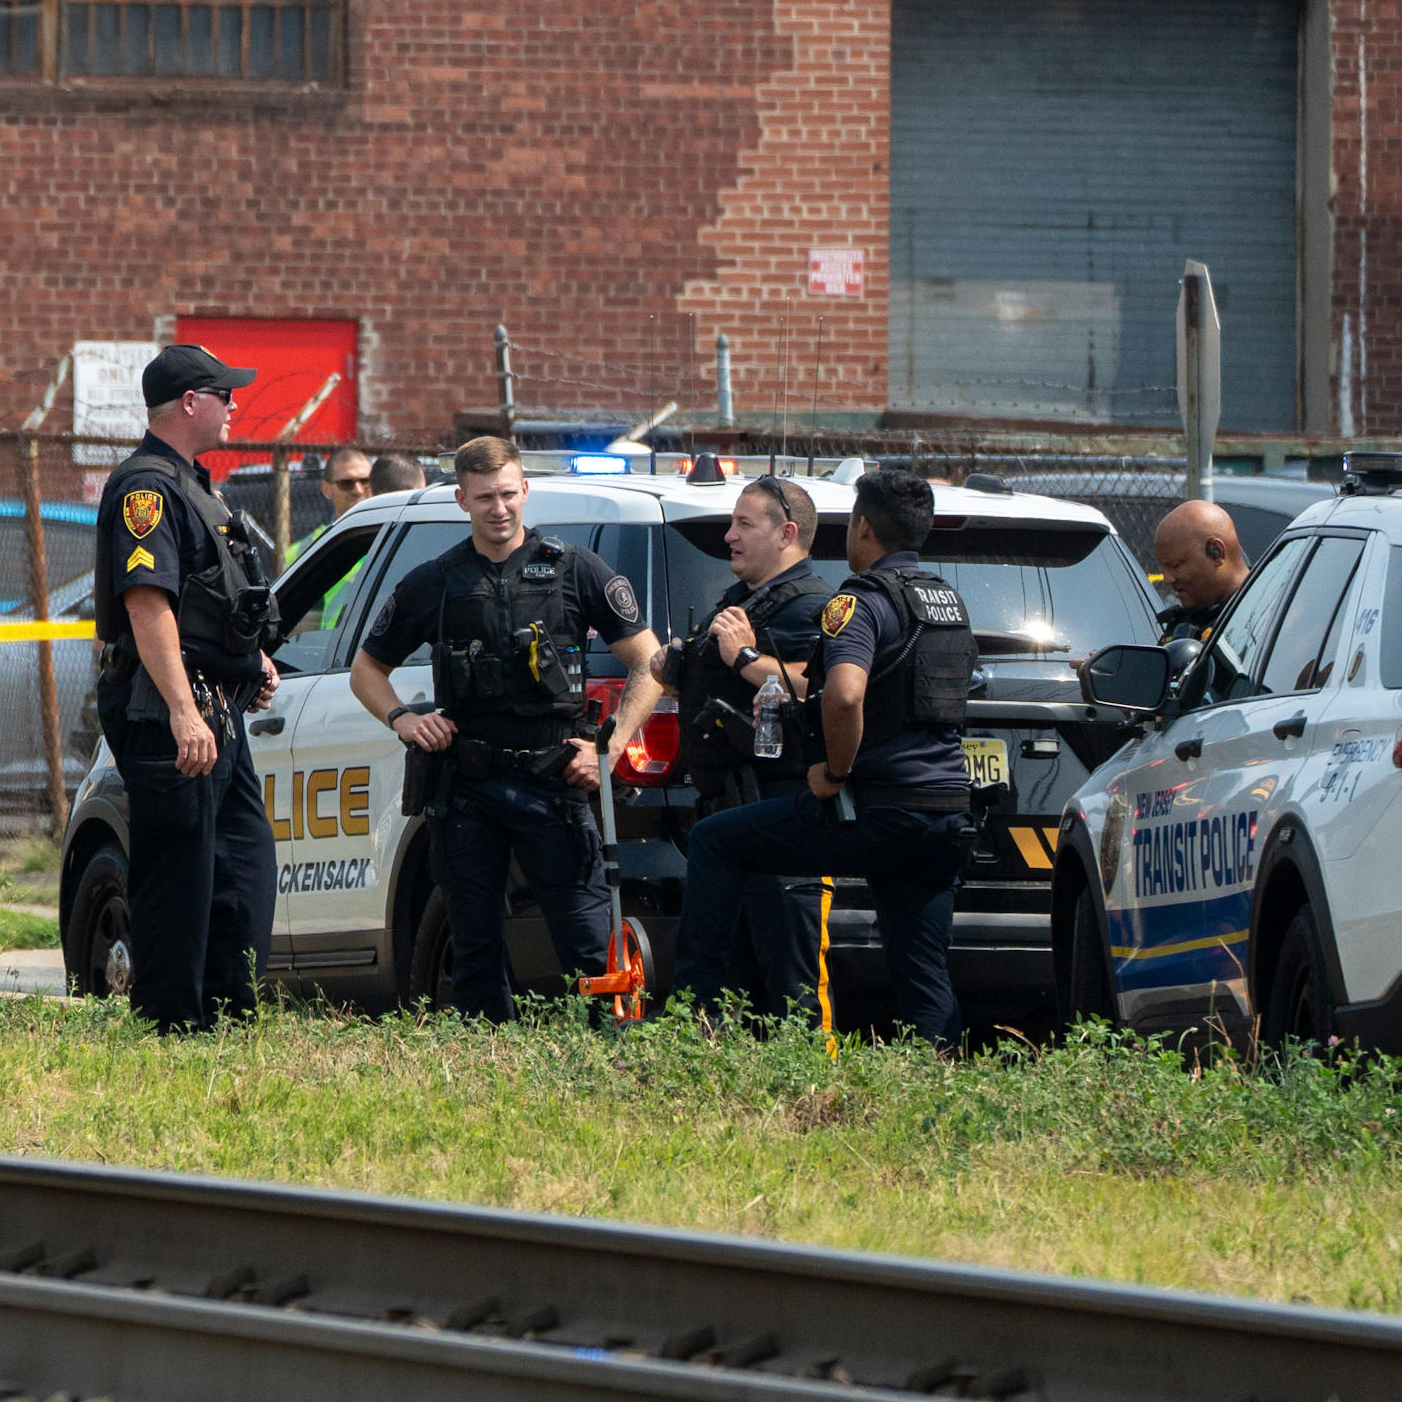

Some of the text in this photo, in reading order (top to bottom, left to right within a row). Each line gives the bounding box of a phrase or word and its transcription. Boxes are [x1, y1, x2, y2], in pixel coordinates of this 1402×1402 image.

[524, 566, 556, 575] POLICE
[914, 587, 958, 604] TRANSIT
[926, 604, 963, 622] POLICE
[1136, 791, 1153, 820] NEW
[1133, 811, 1258, 898] TRANSIT POLICE
